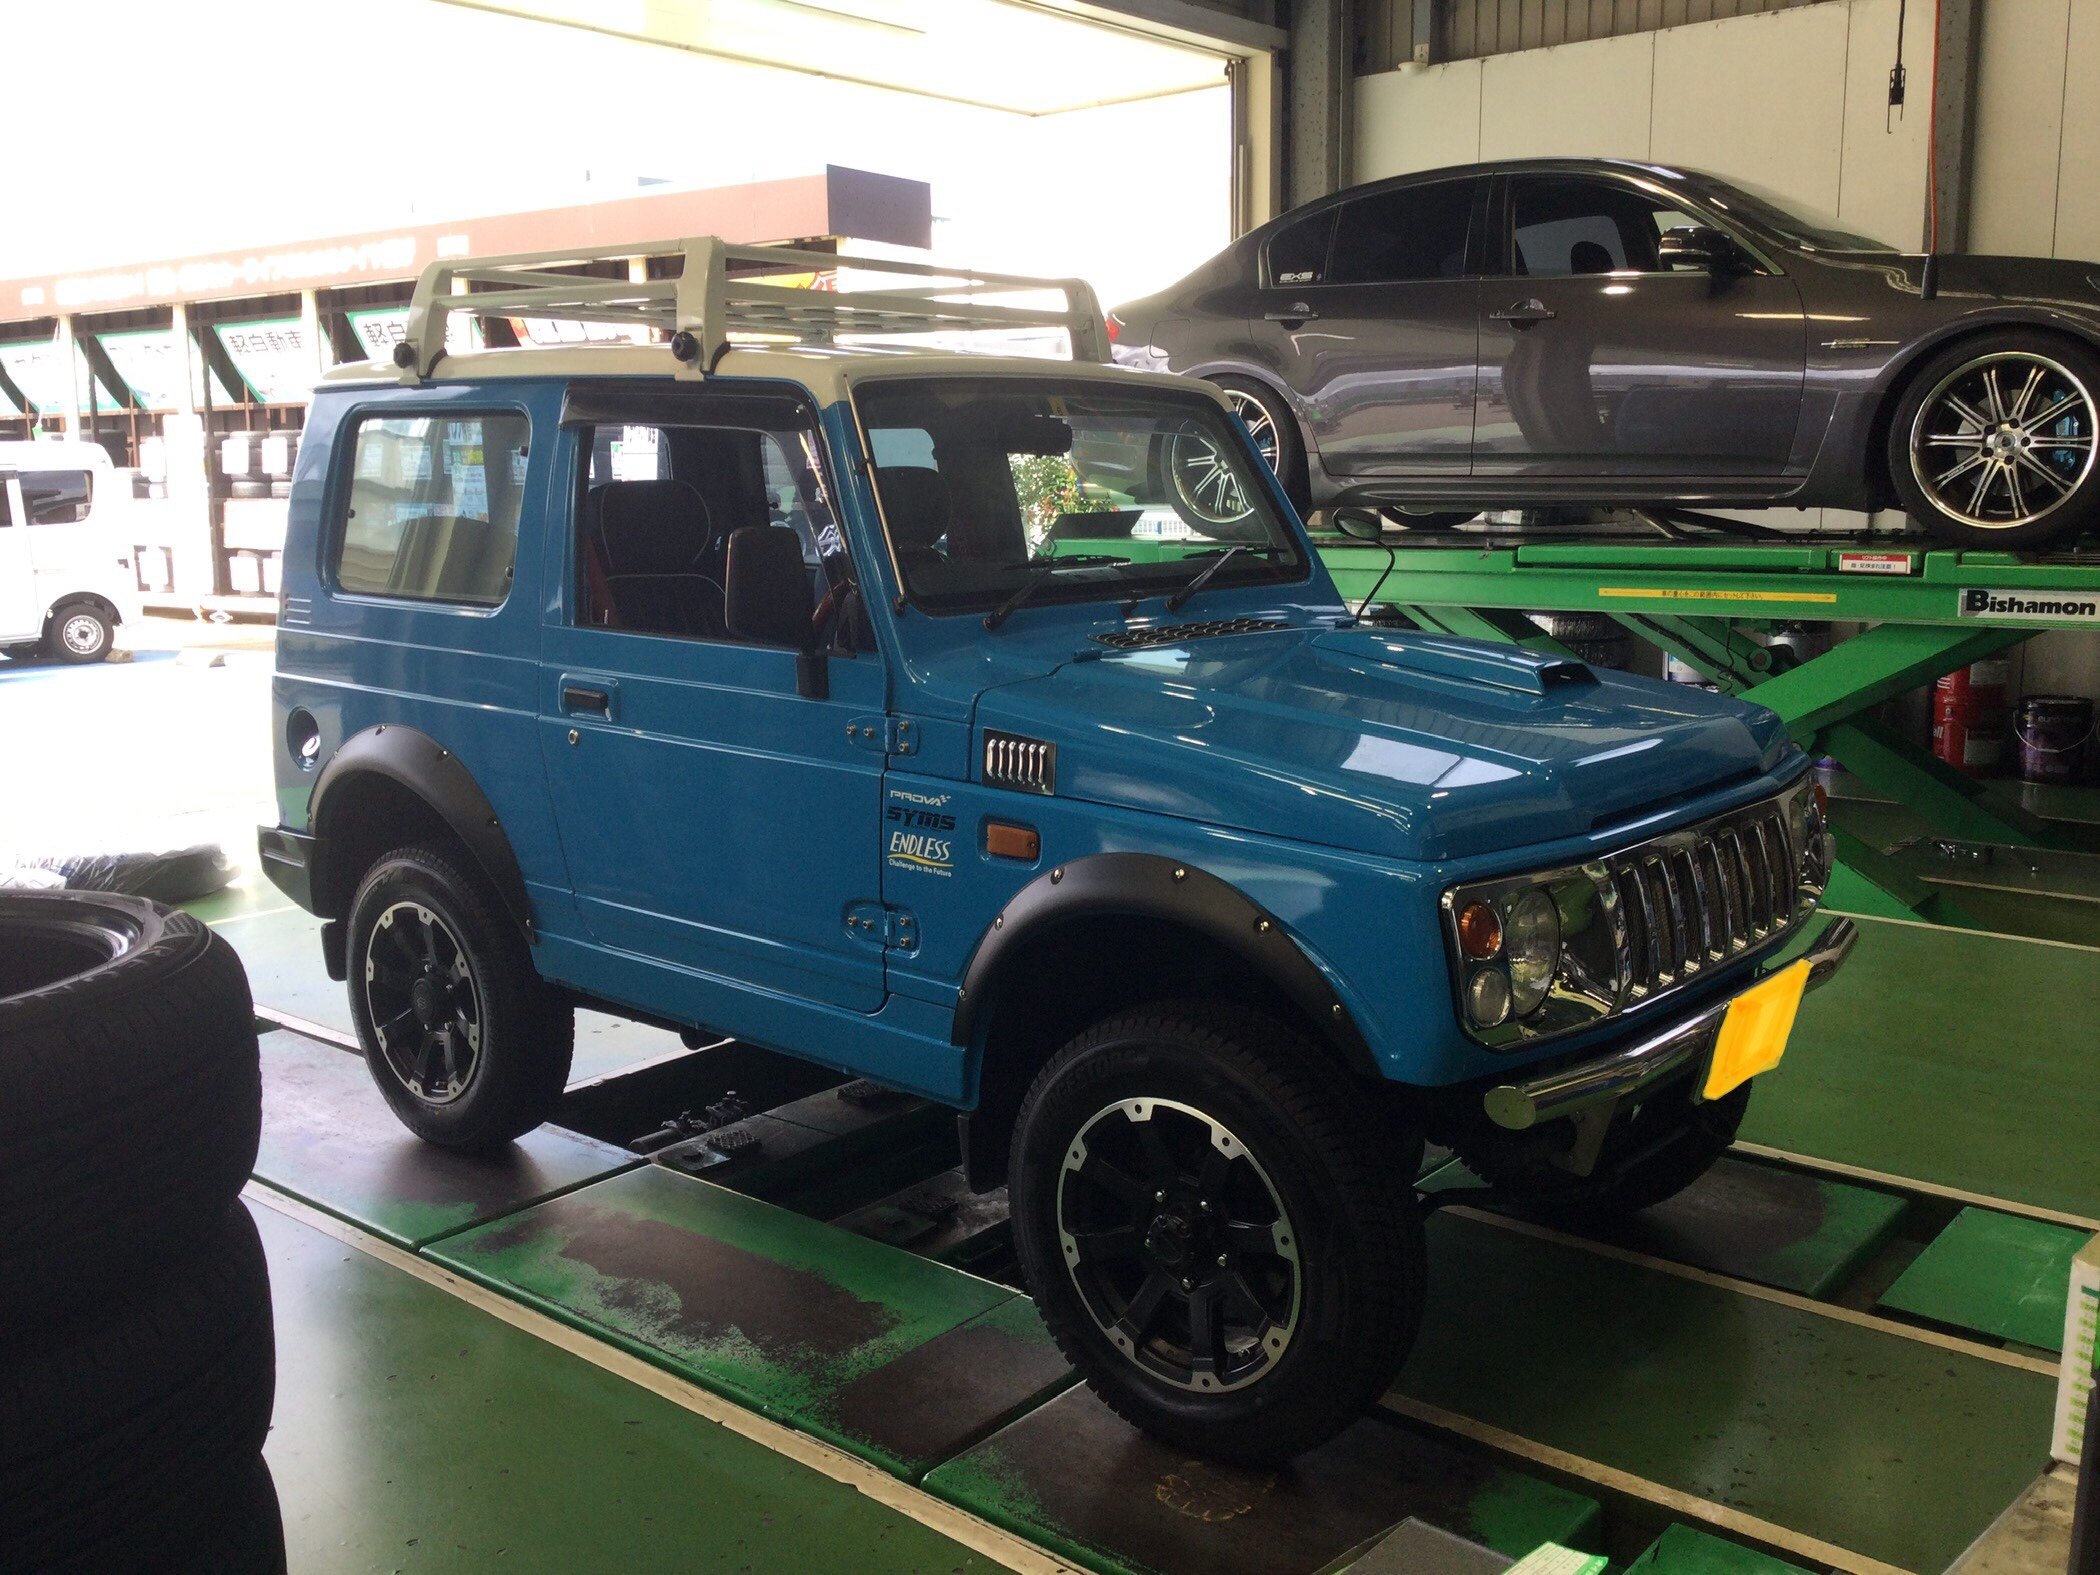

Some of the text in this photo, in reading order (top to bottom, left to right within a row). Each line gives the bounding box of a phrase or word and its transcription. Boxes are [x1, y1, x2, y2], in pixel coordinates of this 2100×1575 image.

[1966, 589, 2097, 616] Bishamon
[890, 790, 942, 806] PROVA
[889, 831, 951, 861] ENDLESS
[888, 858, 952, 878] Challenge to the Future
